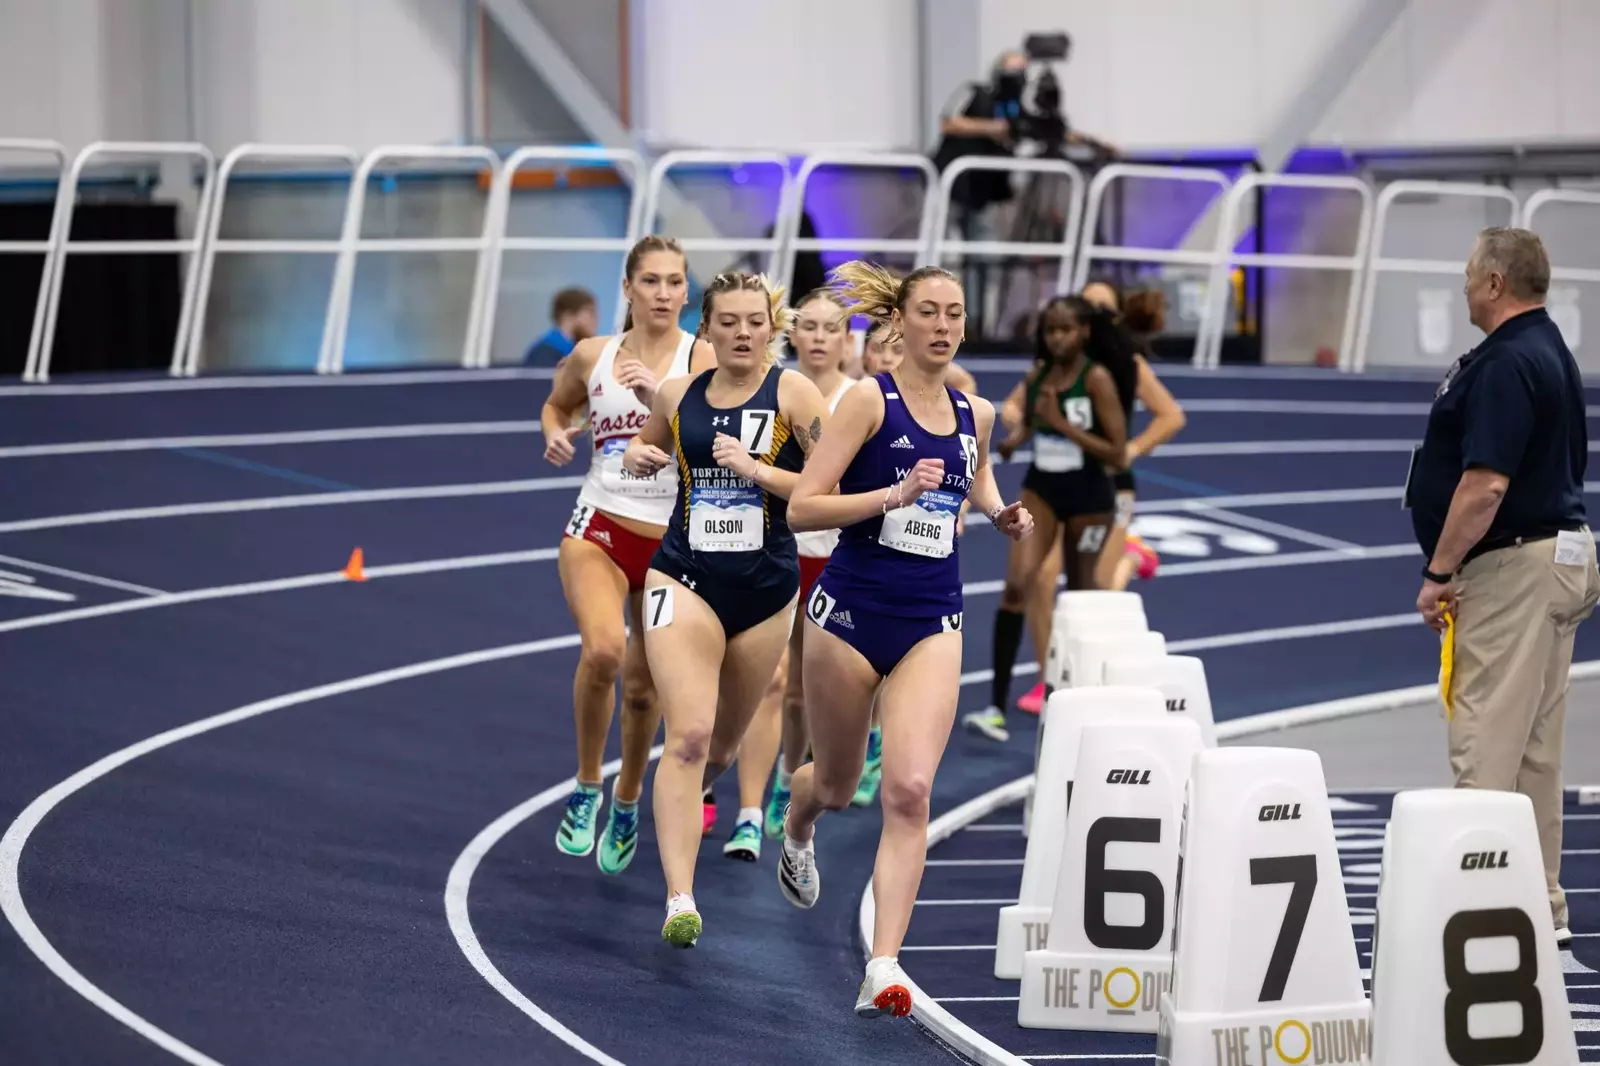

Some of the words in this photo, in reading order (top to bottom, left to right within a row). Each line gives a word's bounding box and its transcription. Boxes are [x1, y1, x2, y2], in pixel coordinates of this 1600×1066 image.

[749, 413, 769, 450] 7
[694, 478, 755, 489] COLORADO
[704, 519, 743, 534] OLSON
[904, 519, 941, 540] ABERG
[651, 589, 667, 626] 7
[812, 589, 828, 620] 6
[829, 613, 855, 630] adidas
[1166, 699, 1187, 711] ILL
[1106, 769, 1152, 785] GILL
[1258, 803, 1302, 822] GILL
[1460, 851, 1509, 870] GILL
[1084, 816, 1165, 951] 6
[1023, 922, 1049, 951] TH
[1250, 854, 1318, 1003] 7
[1043, 967, 1081, 1009] THE
[1443, 907, 1544, 1066] 8
[1211, 1026, 1251, 1066] THE
